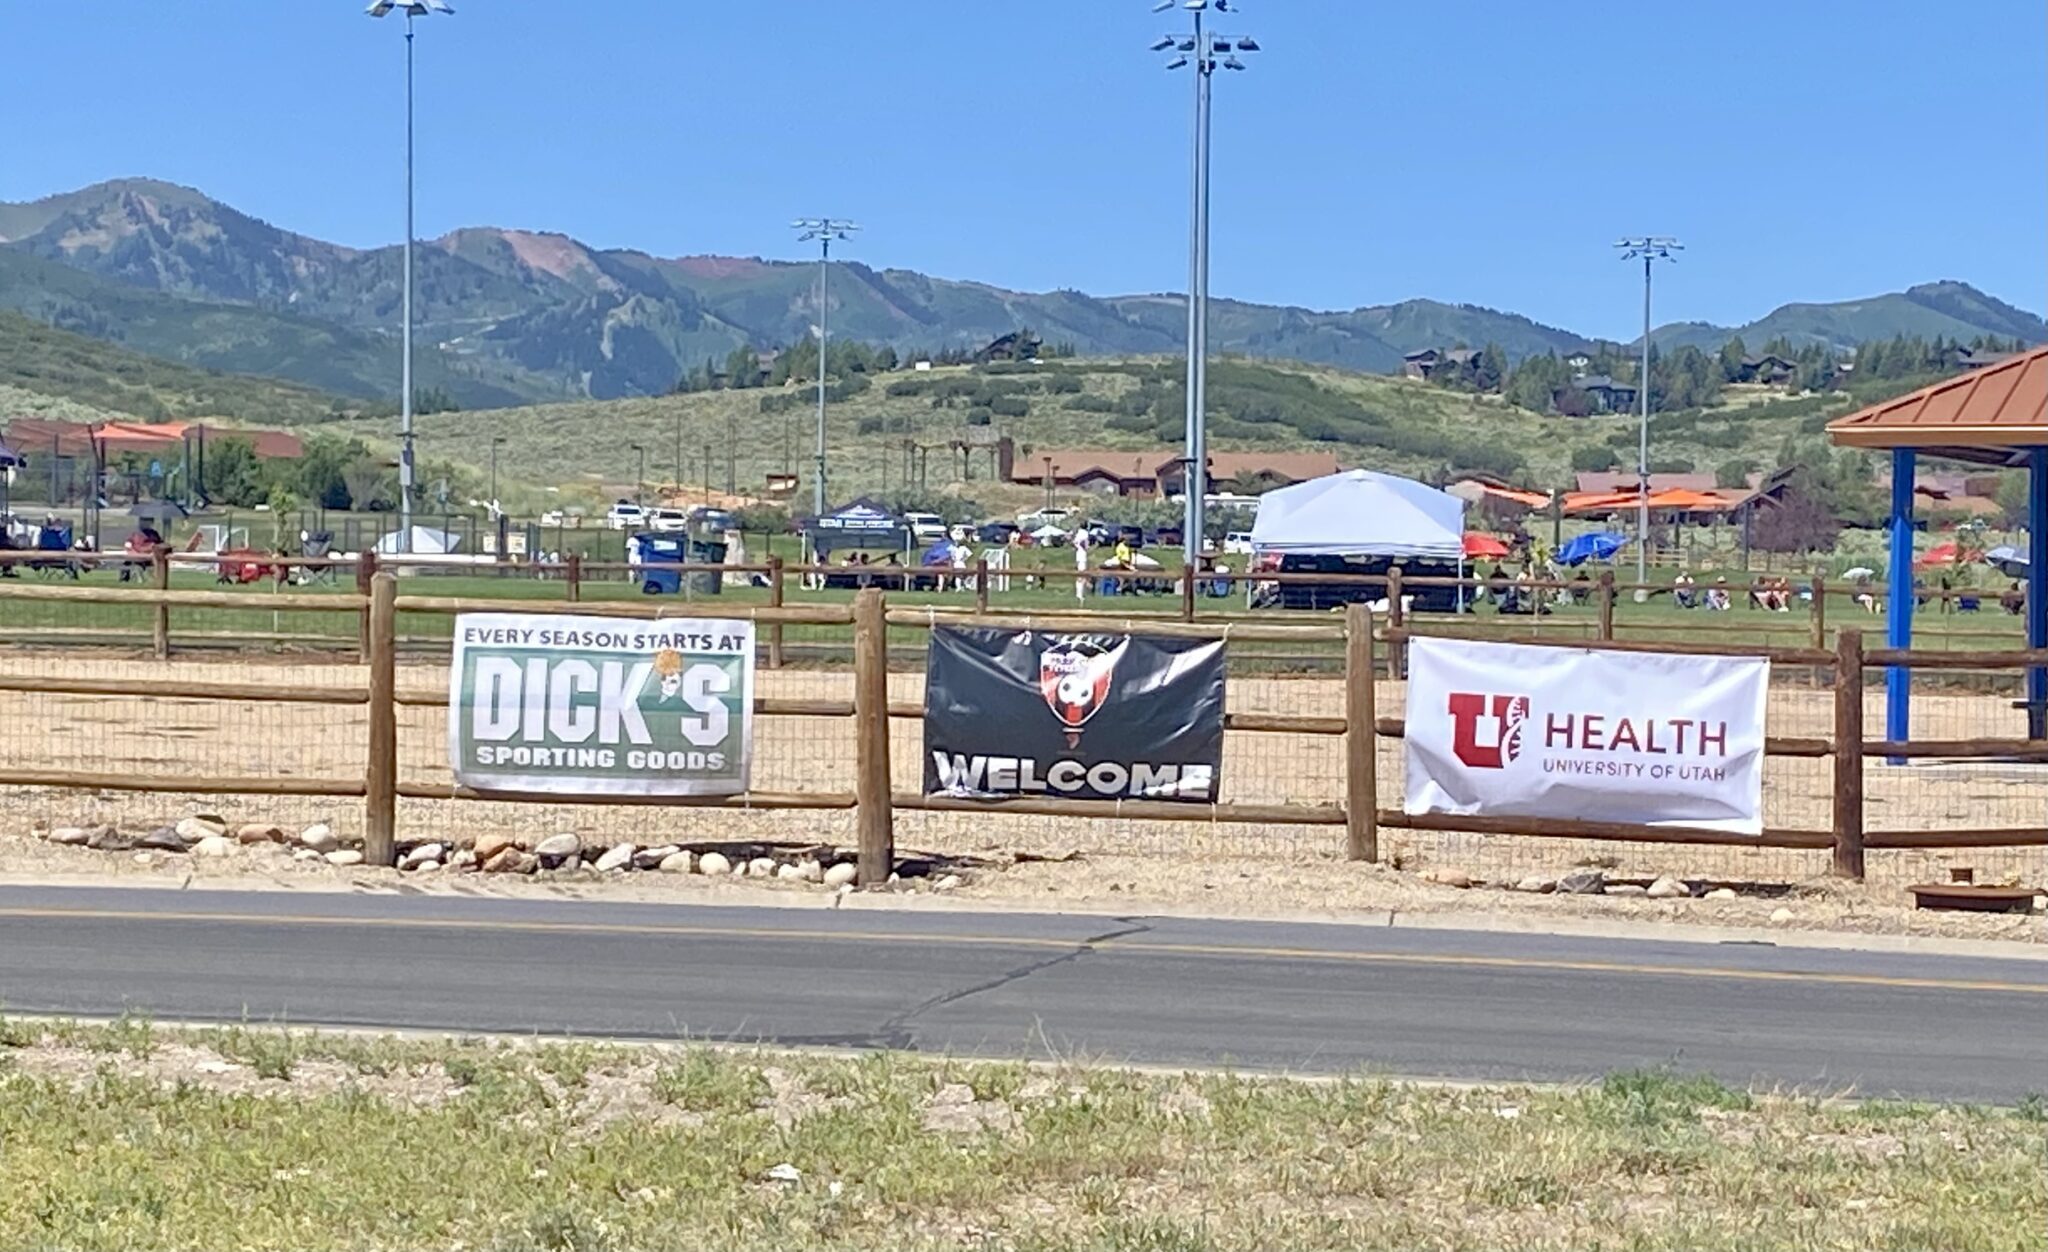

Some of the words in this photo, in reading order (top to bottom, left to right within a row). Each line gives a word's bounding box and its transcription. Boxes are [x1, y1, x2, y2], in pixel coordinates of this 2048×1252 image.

[465, 628, 533, 644] EVERY
[540, 629, 628, 648] SEASON
[634, 633, 712, 650] STARTS
[719, 635, 746, 651] AT
[473, 656, 731, 747] DICK'S
[1545, 712, 1727, 757] HEALTH
[476, 746, 616, 768] SPORTING
[627, 751, 726, 771] GOODS
[931, 749, 1213, 800] WELCOME
[1543, 759, 1645, 778] UNIVERSITY
[1651, 765, 1674, 779] OF
[1680, 766, 1727, 781] UTAH
